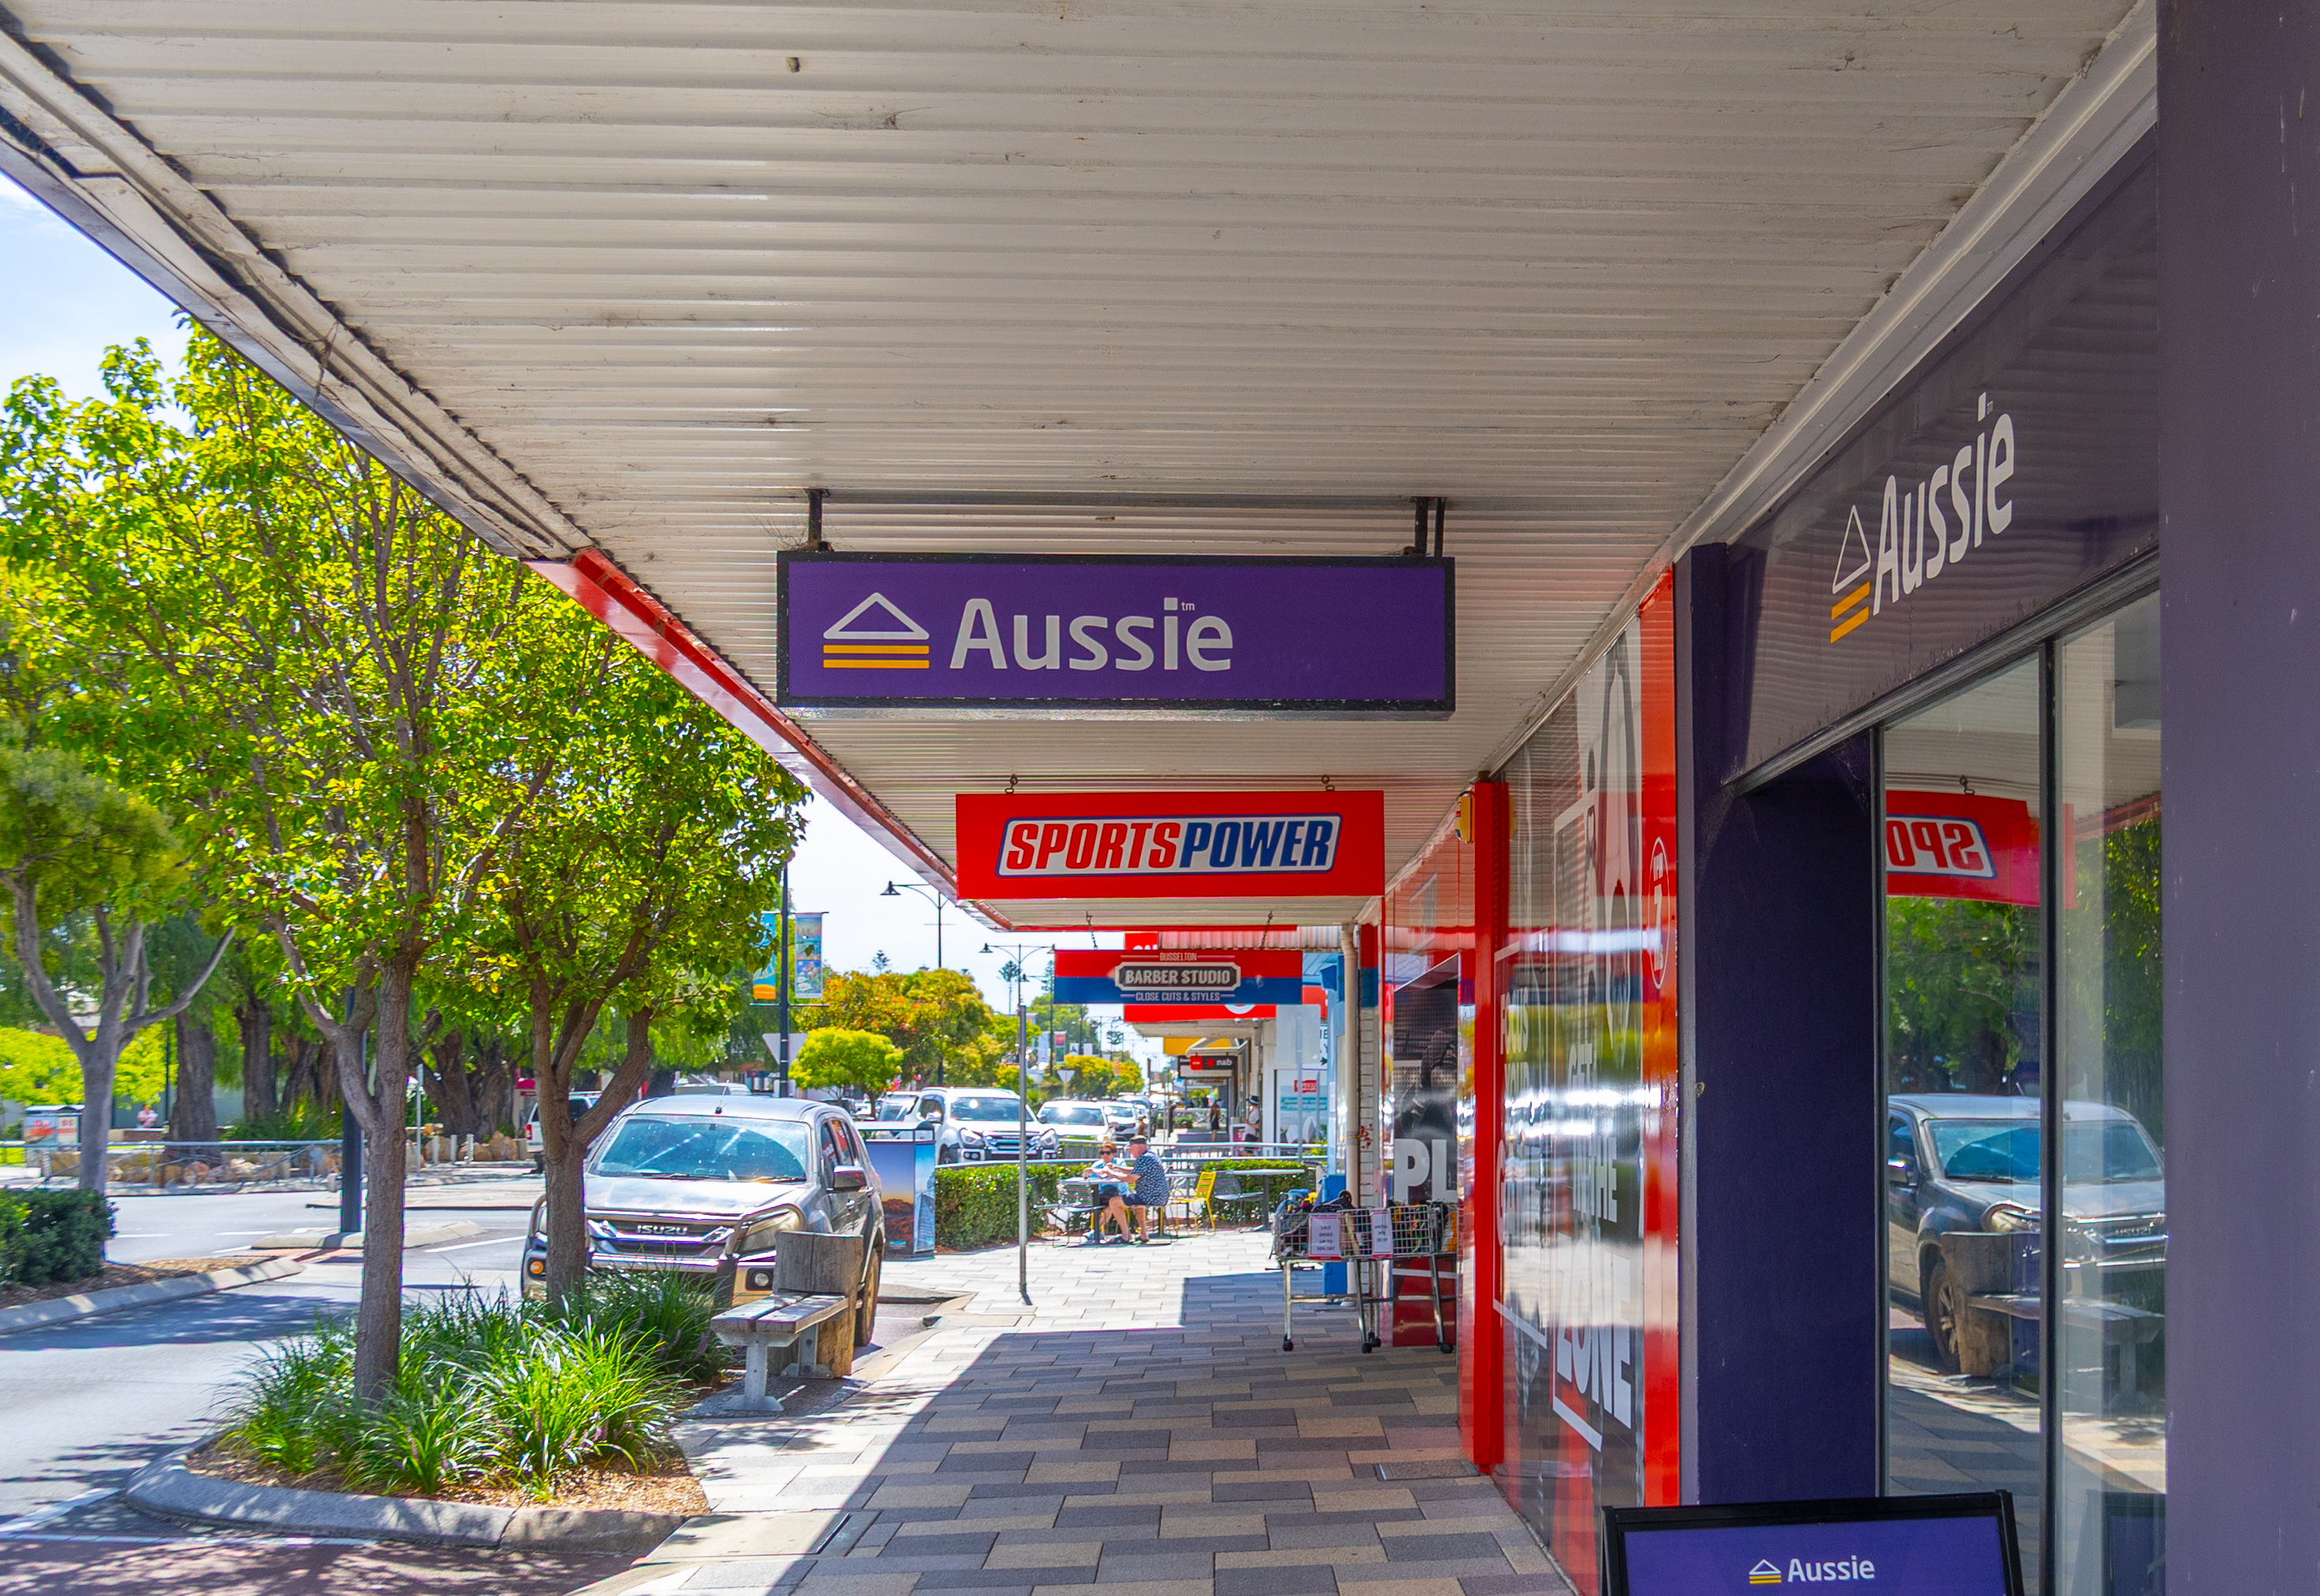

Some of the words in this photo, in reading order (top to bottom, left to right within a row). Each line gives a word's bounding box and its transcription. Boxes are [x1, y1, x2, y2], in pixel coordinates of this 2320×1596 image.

[1873, 391, 2014, 616] Aussie
[950, 597, 1234, 672] Aussie
[1006, 820, 1333, 869] SPORTSPOWER
[1159, 952, 1197, 961] BUSSELTON
[1125, 969, 1178, 985] BARBER
[1180, 969, 1231, 984] STUDIO
[1135, 992, 1159, 1002] CLOSE
[1161, 992, 1182, 1002] CUTS
[1183, 992, 1190, 1002] &
[1191, 992, 1221, 1002] STYLES
[1588, 1135, 1618, 1224] THE
[636, 1224, 688, 1236] ISUZU
[1556, 1231, 1633, 1429] ZONE
[1787, 1554, 1875, 1583] Aussie
